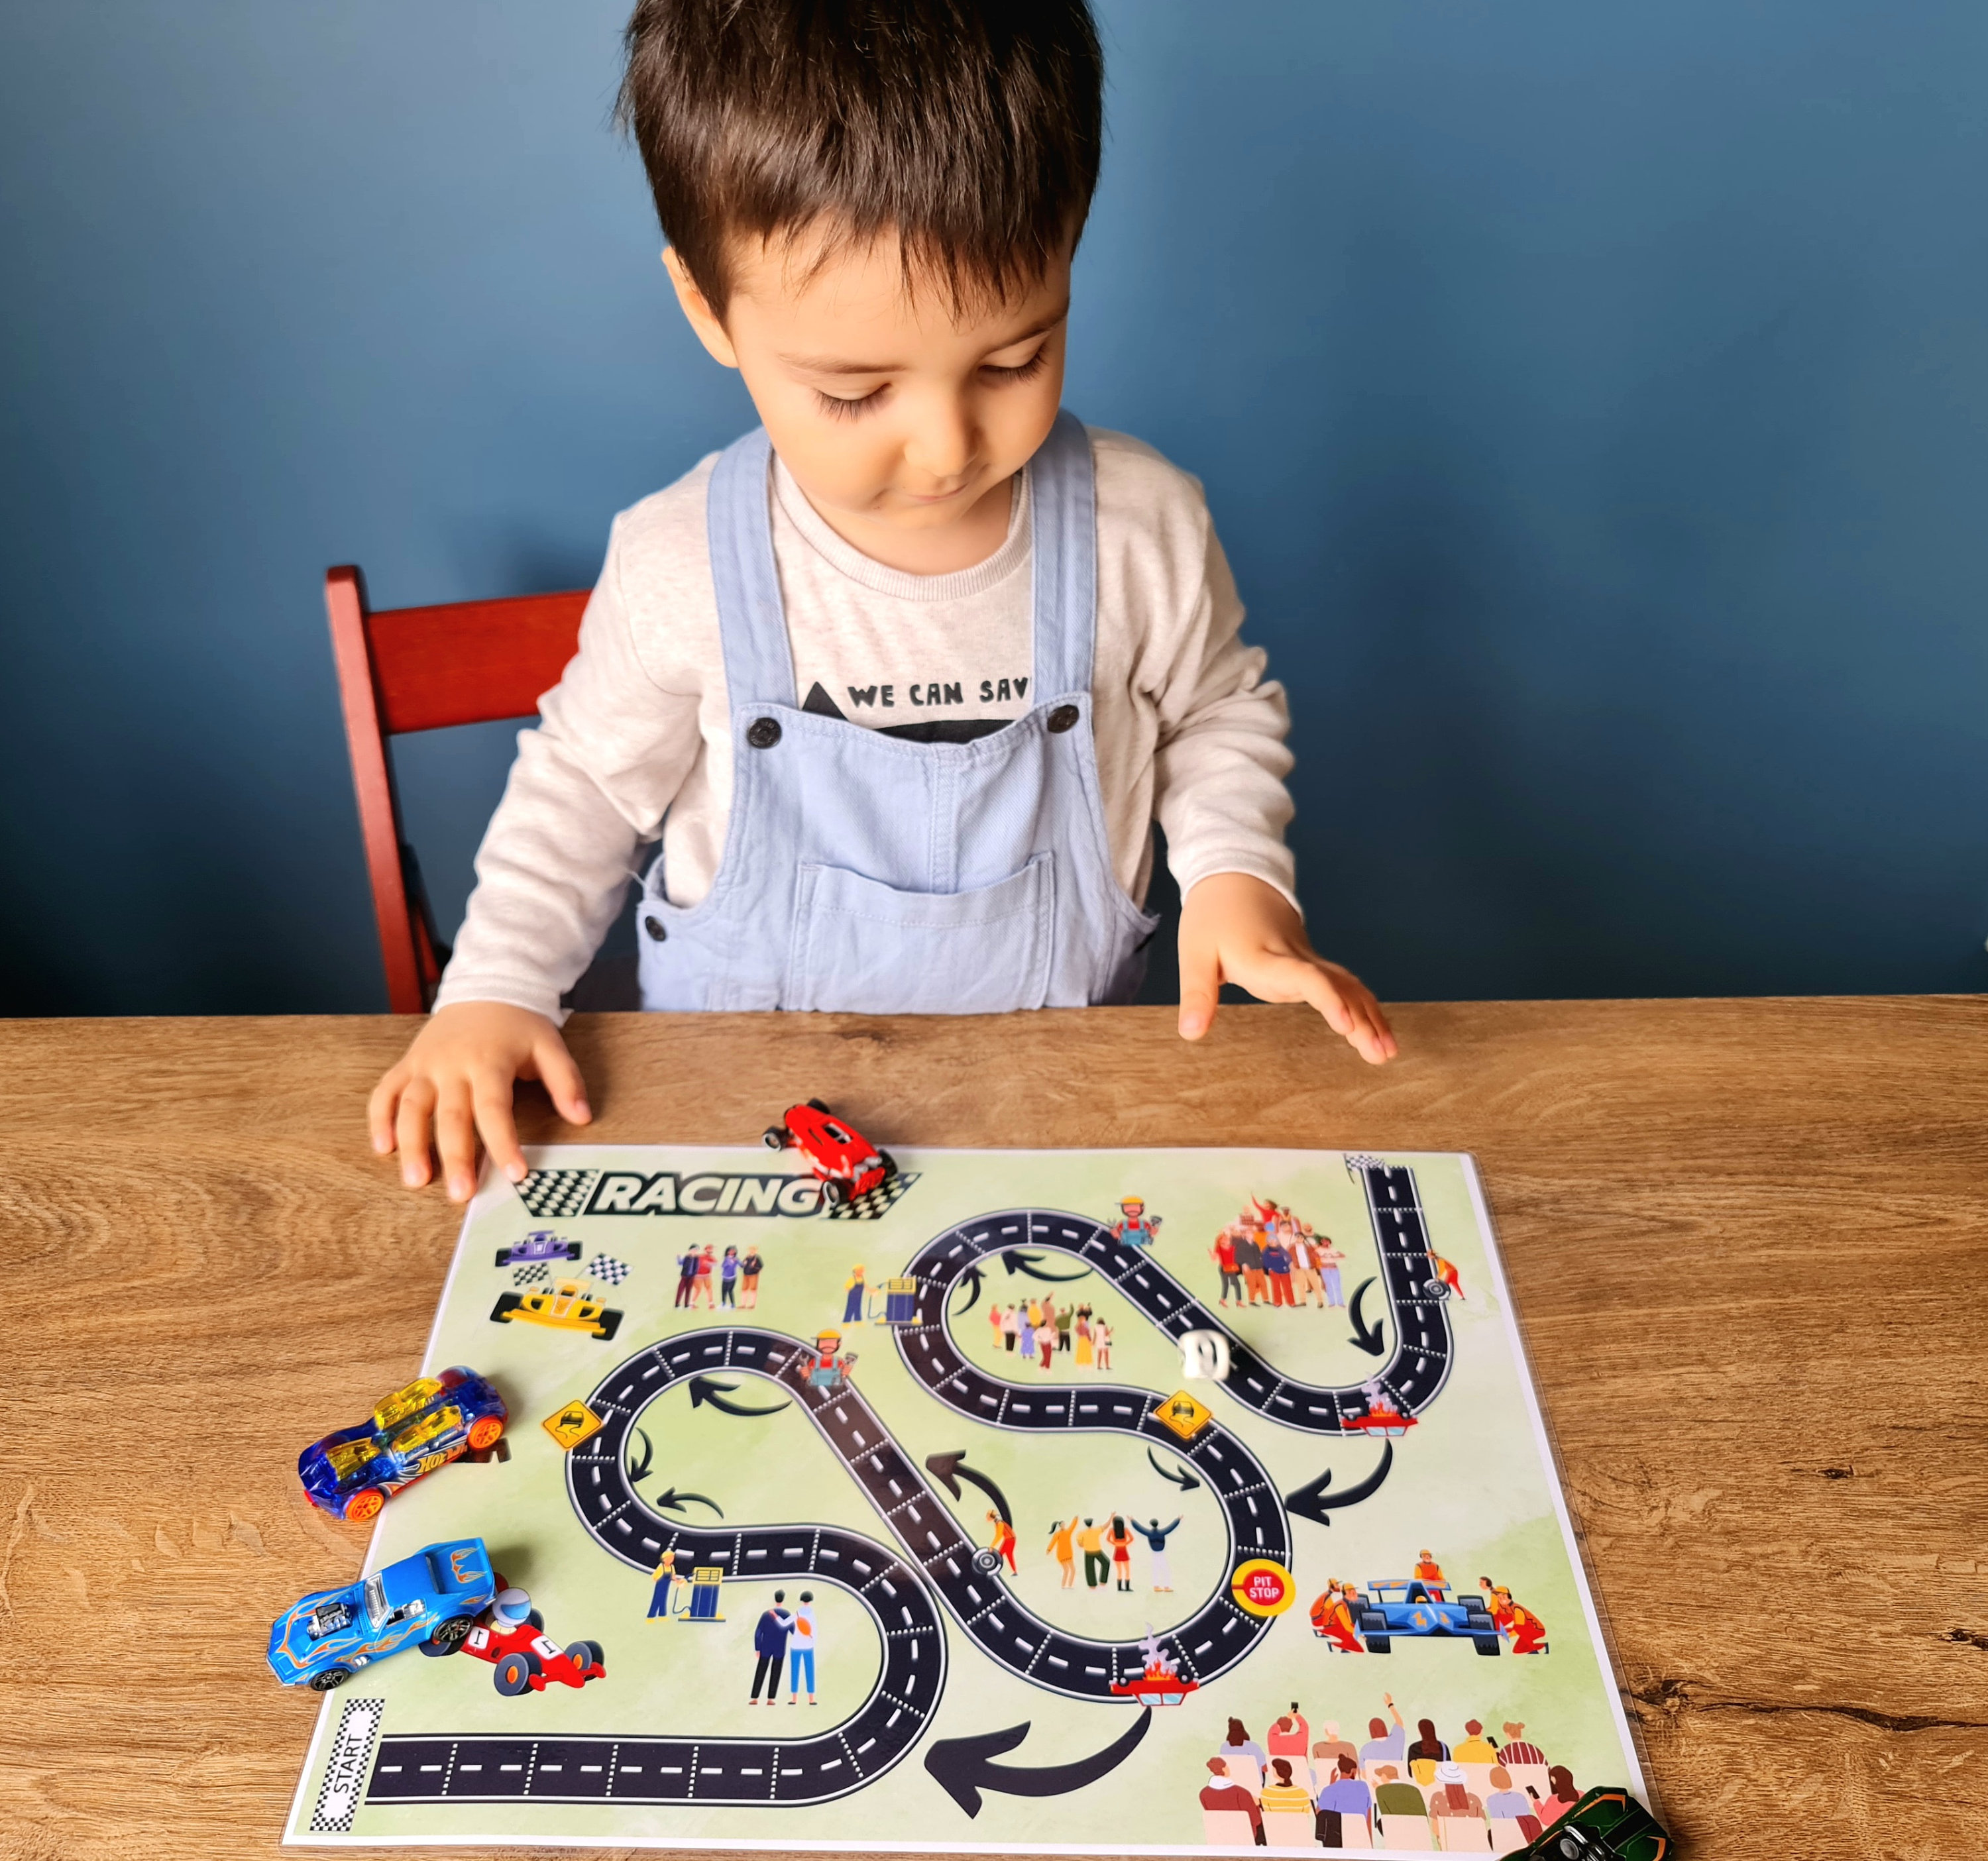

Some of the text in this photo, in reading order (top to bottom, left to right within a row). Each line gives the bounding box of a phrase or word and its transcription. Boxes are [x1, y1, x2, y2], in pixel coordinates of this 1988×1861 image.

[848, 676, 1032, 707] WE CAN SAV
[591, 1174, 825, 1215] RACING
[1249, 1587, 1280, 1598] STOP
[1253, 1576, 1272, 1587] PIT
[333, 1733, 362, 1793] START
